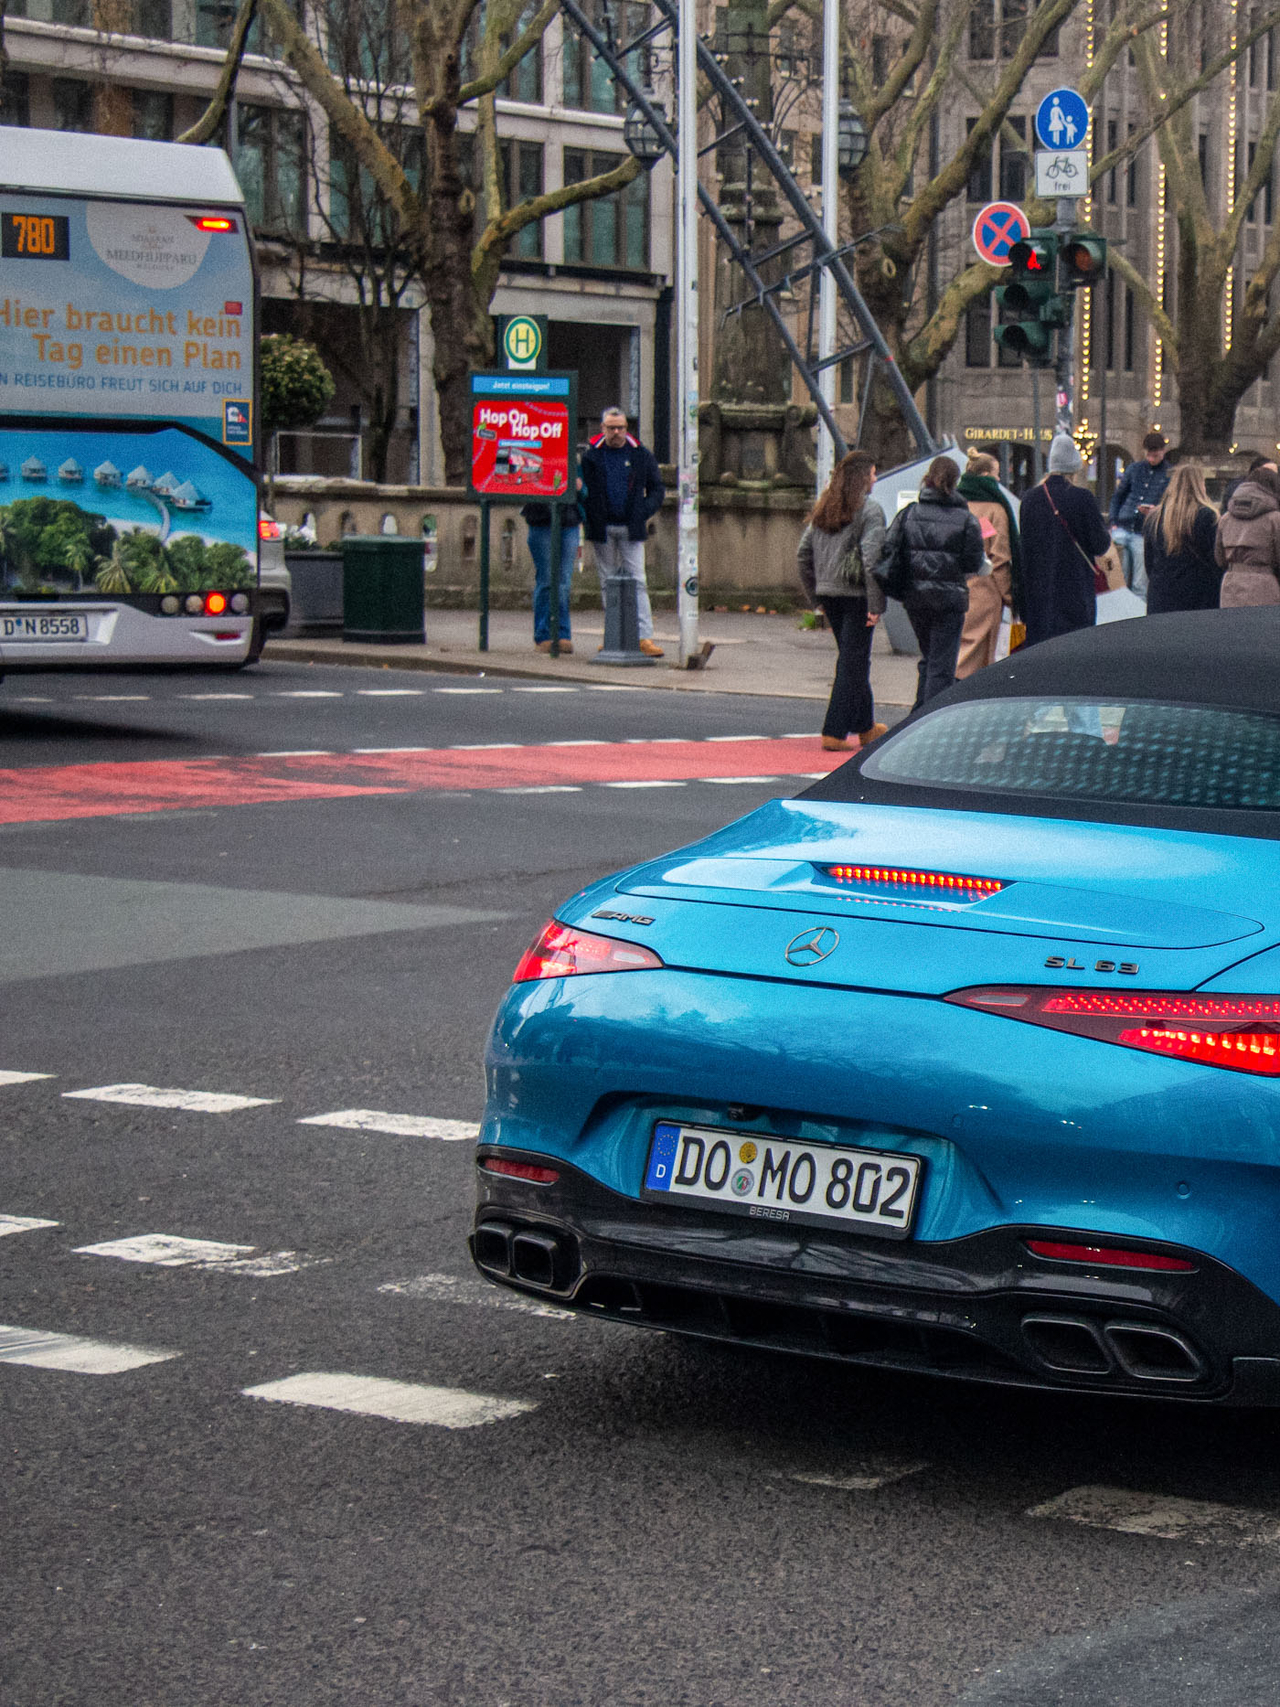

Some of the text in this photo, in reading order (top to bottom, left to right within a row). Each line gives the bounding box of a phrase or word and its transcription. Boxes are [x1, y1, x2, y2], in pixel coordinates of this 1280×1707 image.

[1054, 180, 1071, 192] frei
[13, 215, 55, 254] 780
[66, 303, 177, 335] braucht
[187, 310, 241, 339] kein
[32, 334, 241, 370] Tag einen Plan
[14, 372, 96, 391] REISEBÜRO
[101, 377, 142, 392] FREUT
[150, 379, 179, 393] SICH
[184, 380, 207, 394] AUF
[213, 381, 242, 395] DICH
[480, 408, 528, 427] Hop On
[512, 421, 563, 440] Hop Off
[965, 427, 1053, 441] GIRARDET-HUS
[40, 617, 80, 634] 8558
[608, 911, 656, 926] AMG
[1044, 956, 1139, 975] SL 63
[655, 1136, 911, 1219] D DO MO 802
[749, 1206, 790, 1221] BERESA
